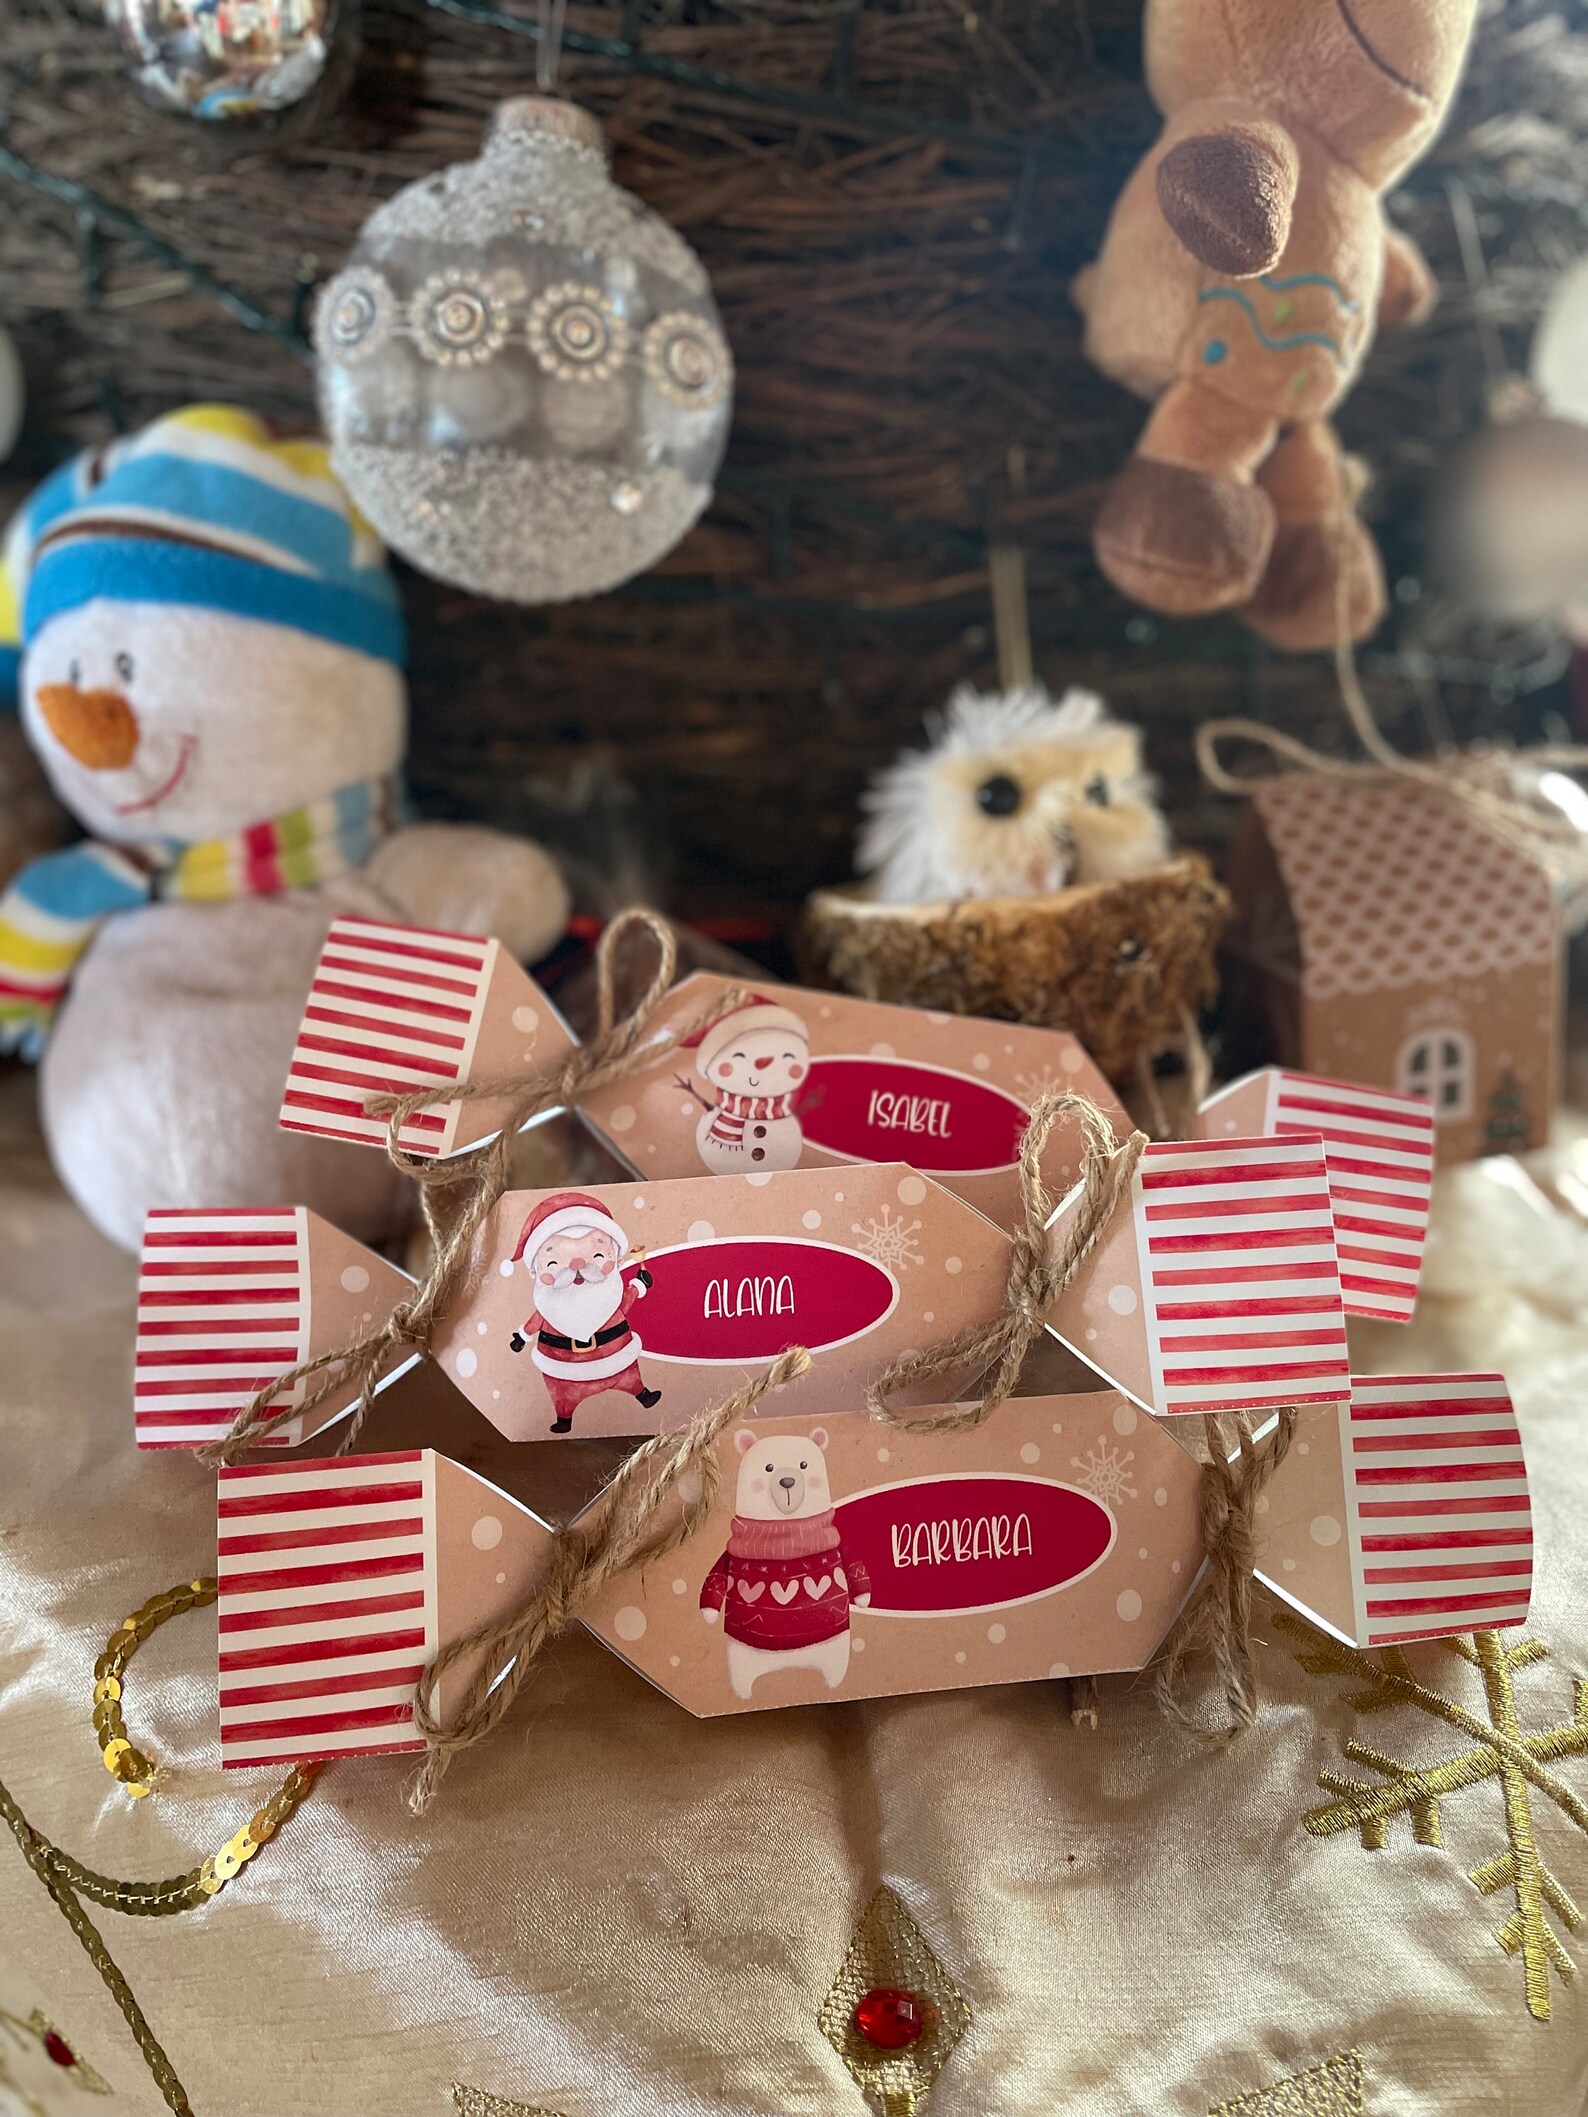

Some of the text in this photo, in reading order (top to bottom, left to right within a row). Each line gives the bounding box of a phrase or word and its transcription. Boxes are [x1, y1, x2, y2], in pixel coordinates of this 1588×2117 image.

[867, 1089, 952, 1139] ISABEL
[704, 1275, 795, 1319] ALANA
[891, 1513, 1033, 1568] BARBARA
